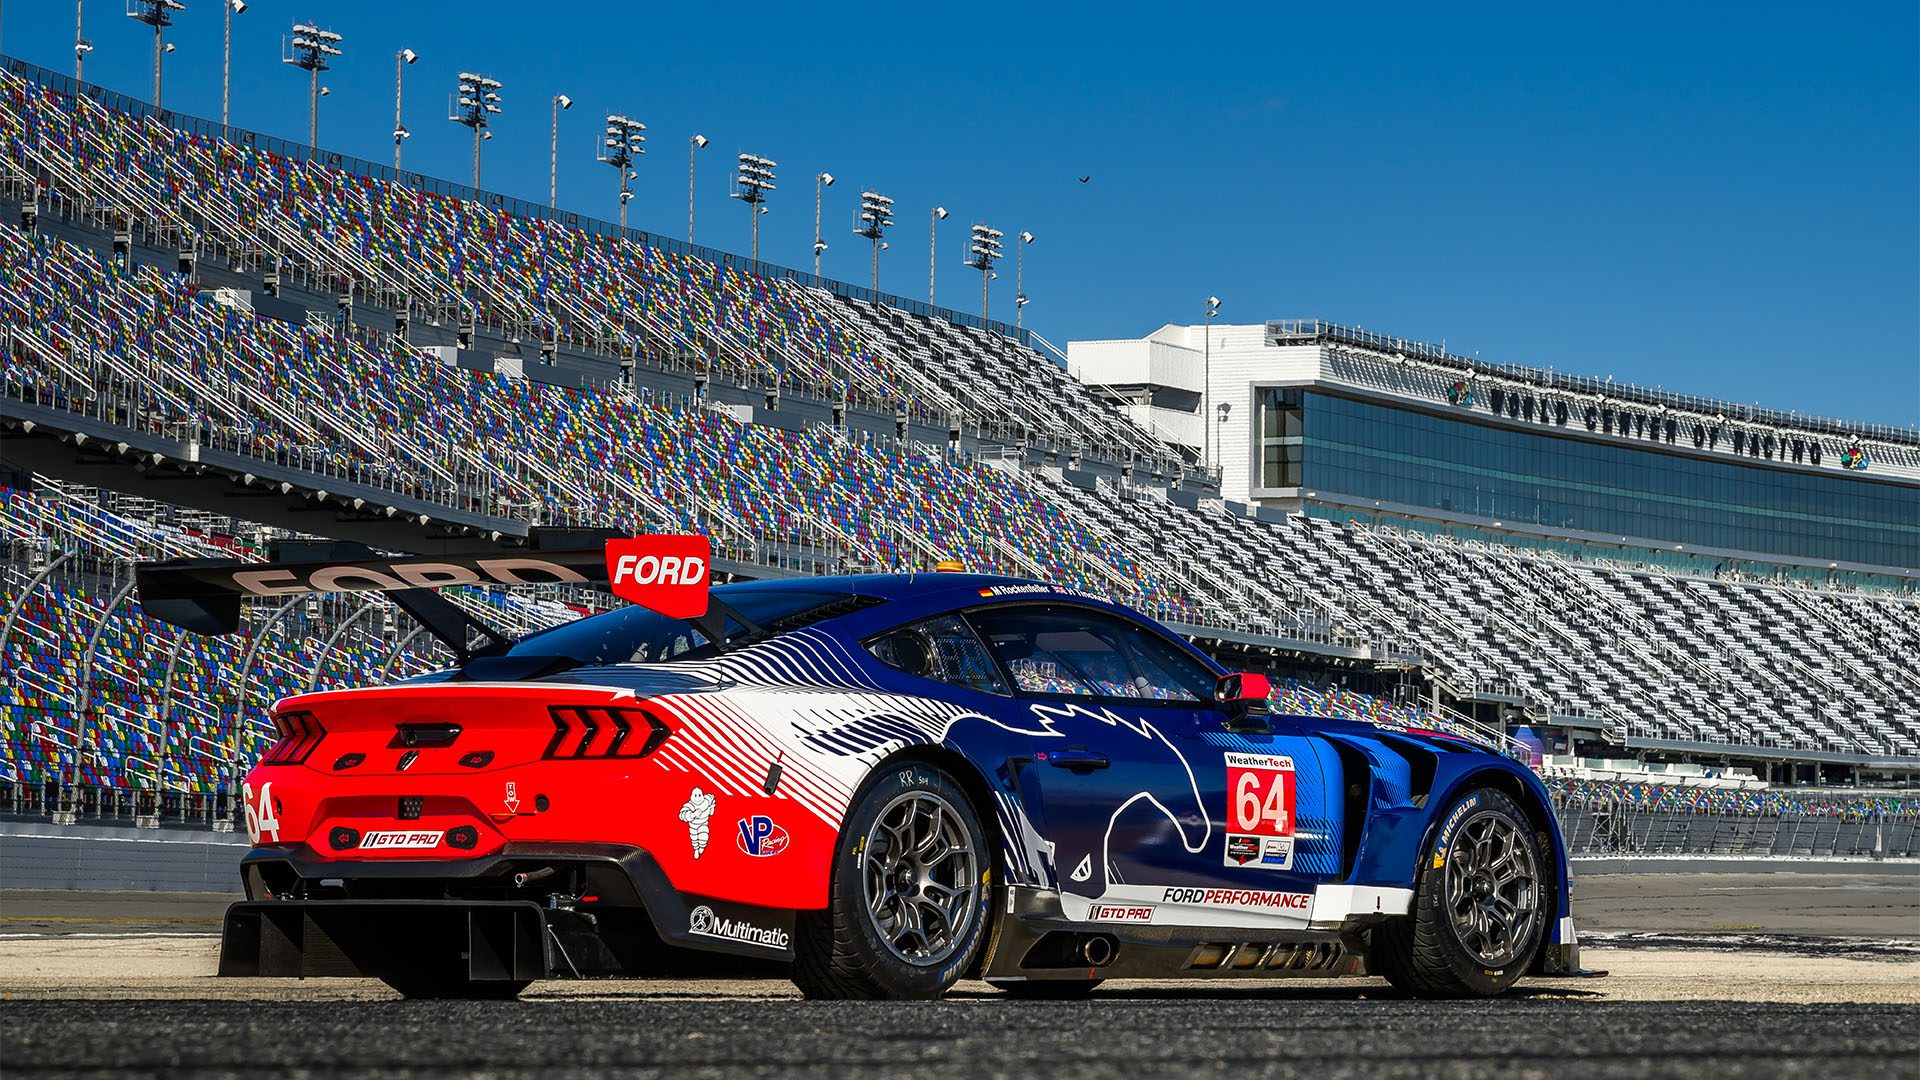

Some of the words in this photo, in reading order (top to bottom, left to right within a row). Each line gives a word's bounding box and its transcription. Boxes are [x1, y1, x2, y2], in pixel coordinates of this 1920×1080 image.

[1490, 388, 1567, 426] WORLD
[1584, 406, 1677, 445] CENTER
[1693, 424, 1719, 451] OF
[1733, 430, 1821, 466] RACING
[613, 555, 705, 585] FORD
[1228, 755, 1291, 768] WeatherTech
[898, 770, 914, 787] RR
[243, 782, 280, 844] 64
[1236, 772, 1288, 831] 64
[738, 815, 774, 855] VP
[1441, 797, 1477, 845] MICHELIN
[377, 835, 407, 845] GTD
[407, 835, 439, 845] PRO
[1162, 887, 1205, 904] FORD
[1203, 889, 1310, 909] PERFORMANCE
[1126, 908, 1152, 920] PRO
[712, 916, 789, 947] Multimatic
